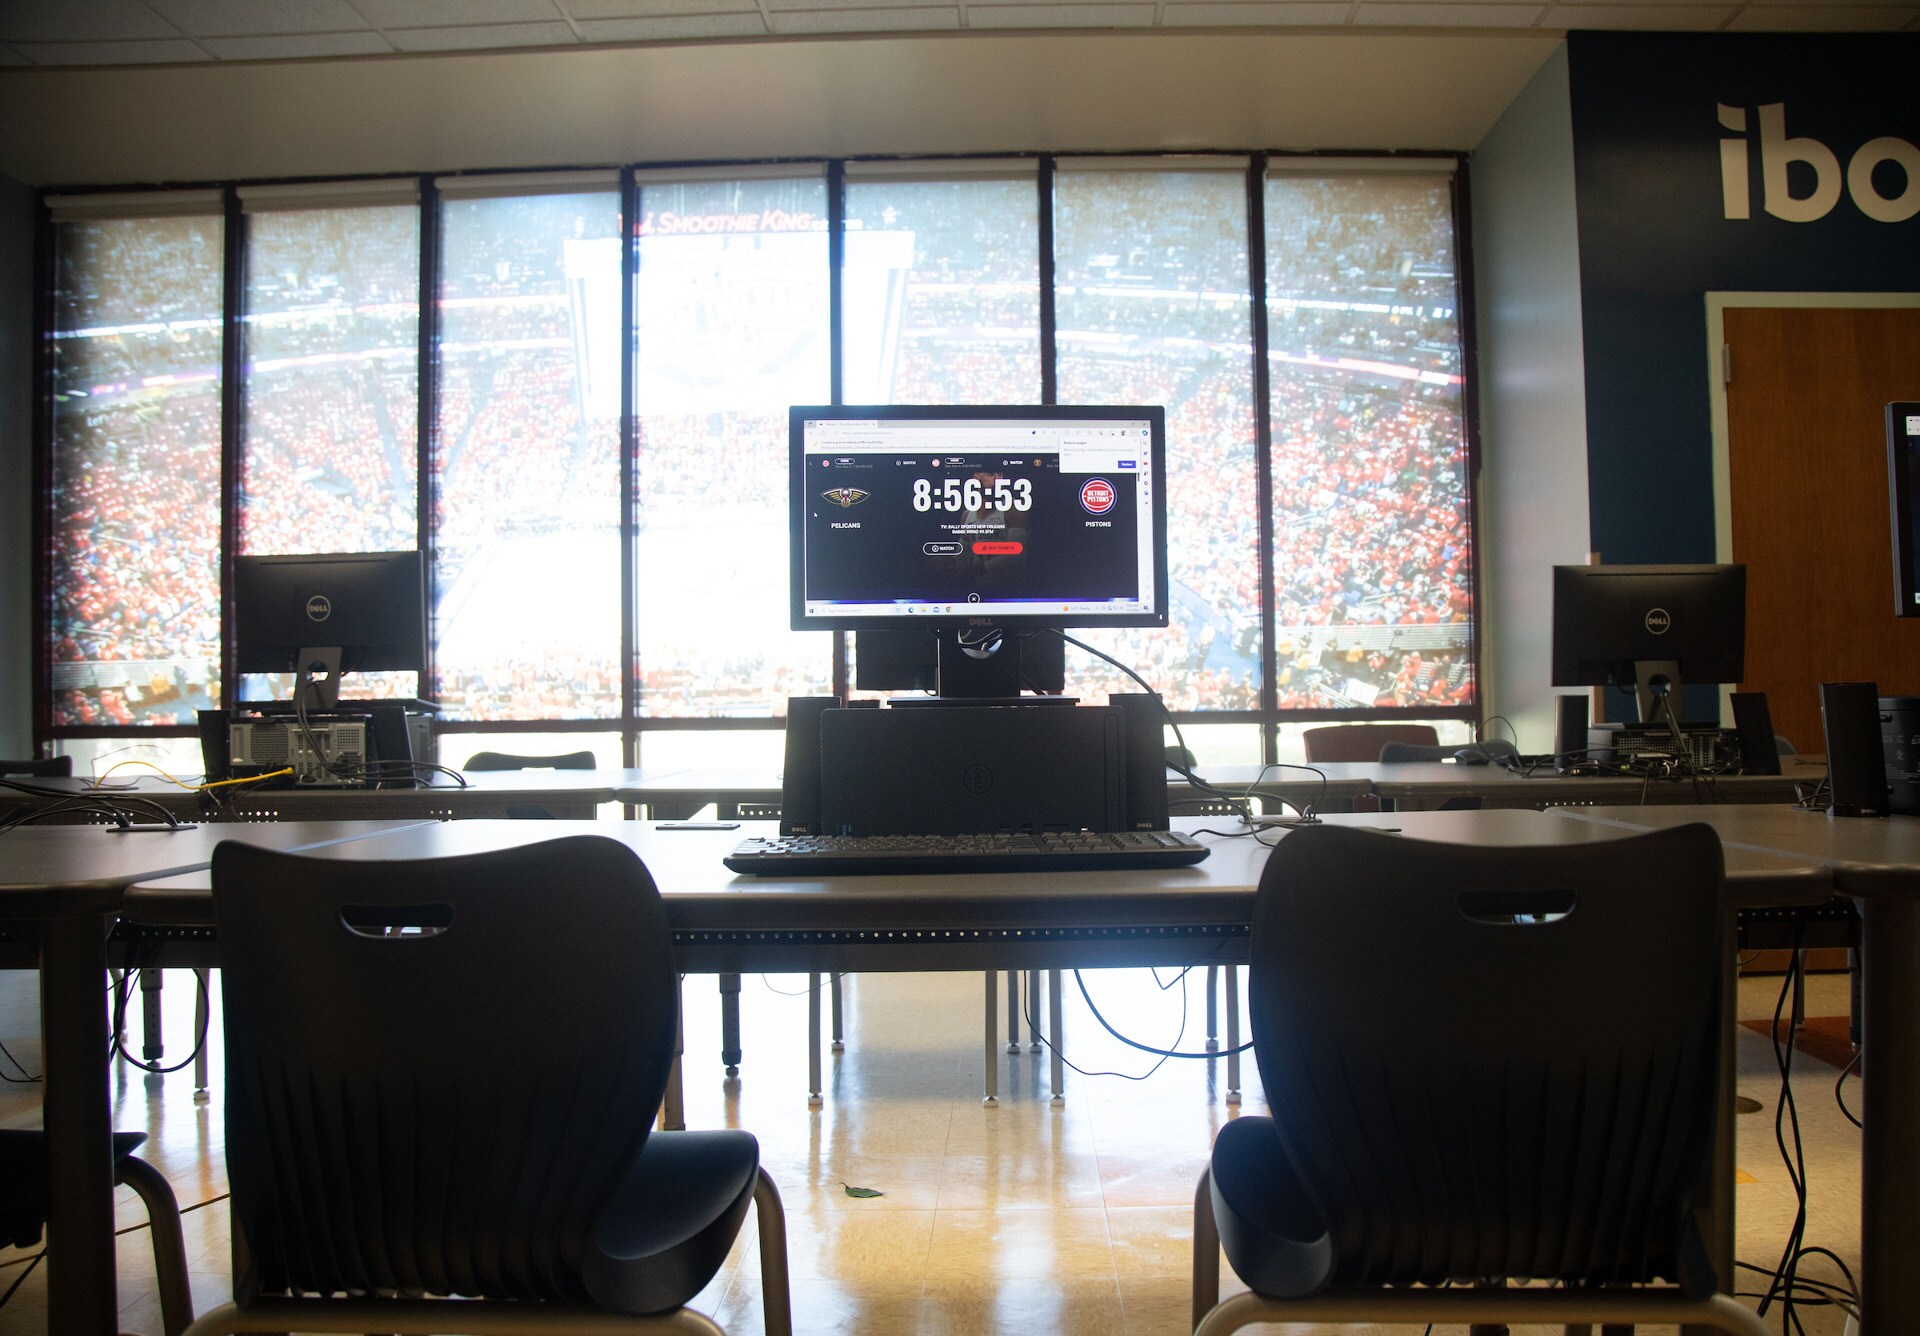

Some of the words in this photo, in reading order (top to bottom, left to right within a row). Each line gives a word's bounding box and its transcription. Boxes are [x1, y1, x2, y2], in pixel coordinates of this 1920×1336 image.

[657, 211, 757, 234] SMOOTHIE
[760, 208, 812, 232] KING
[912, 478, 1033, 512] 8:56:53
[969, 618, 993, 626] DELL
